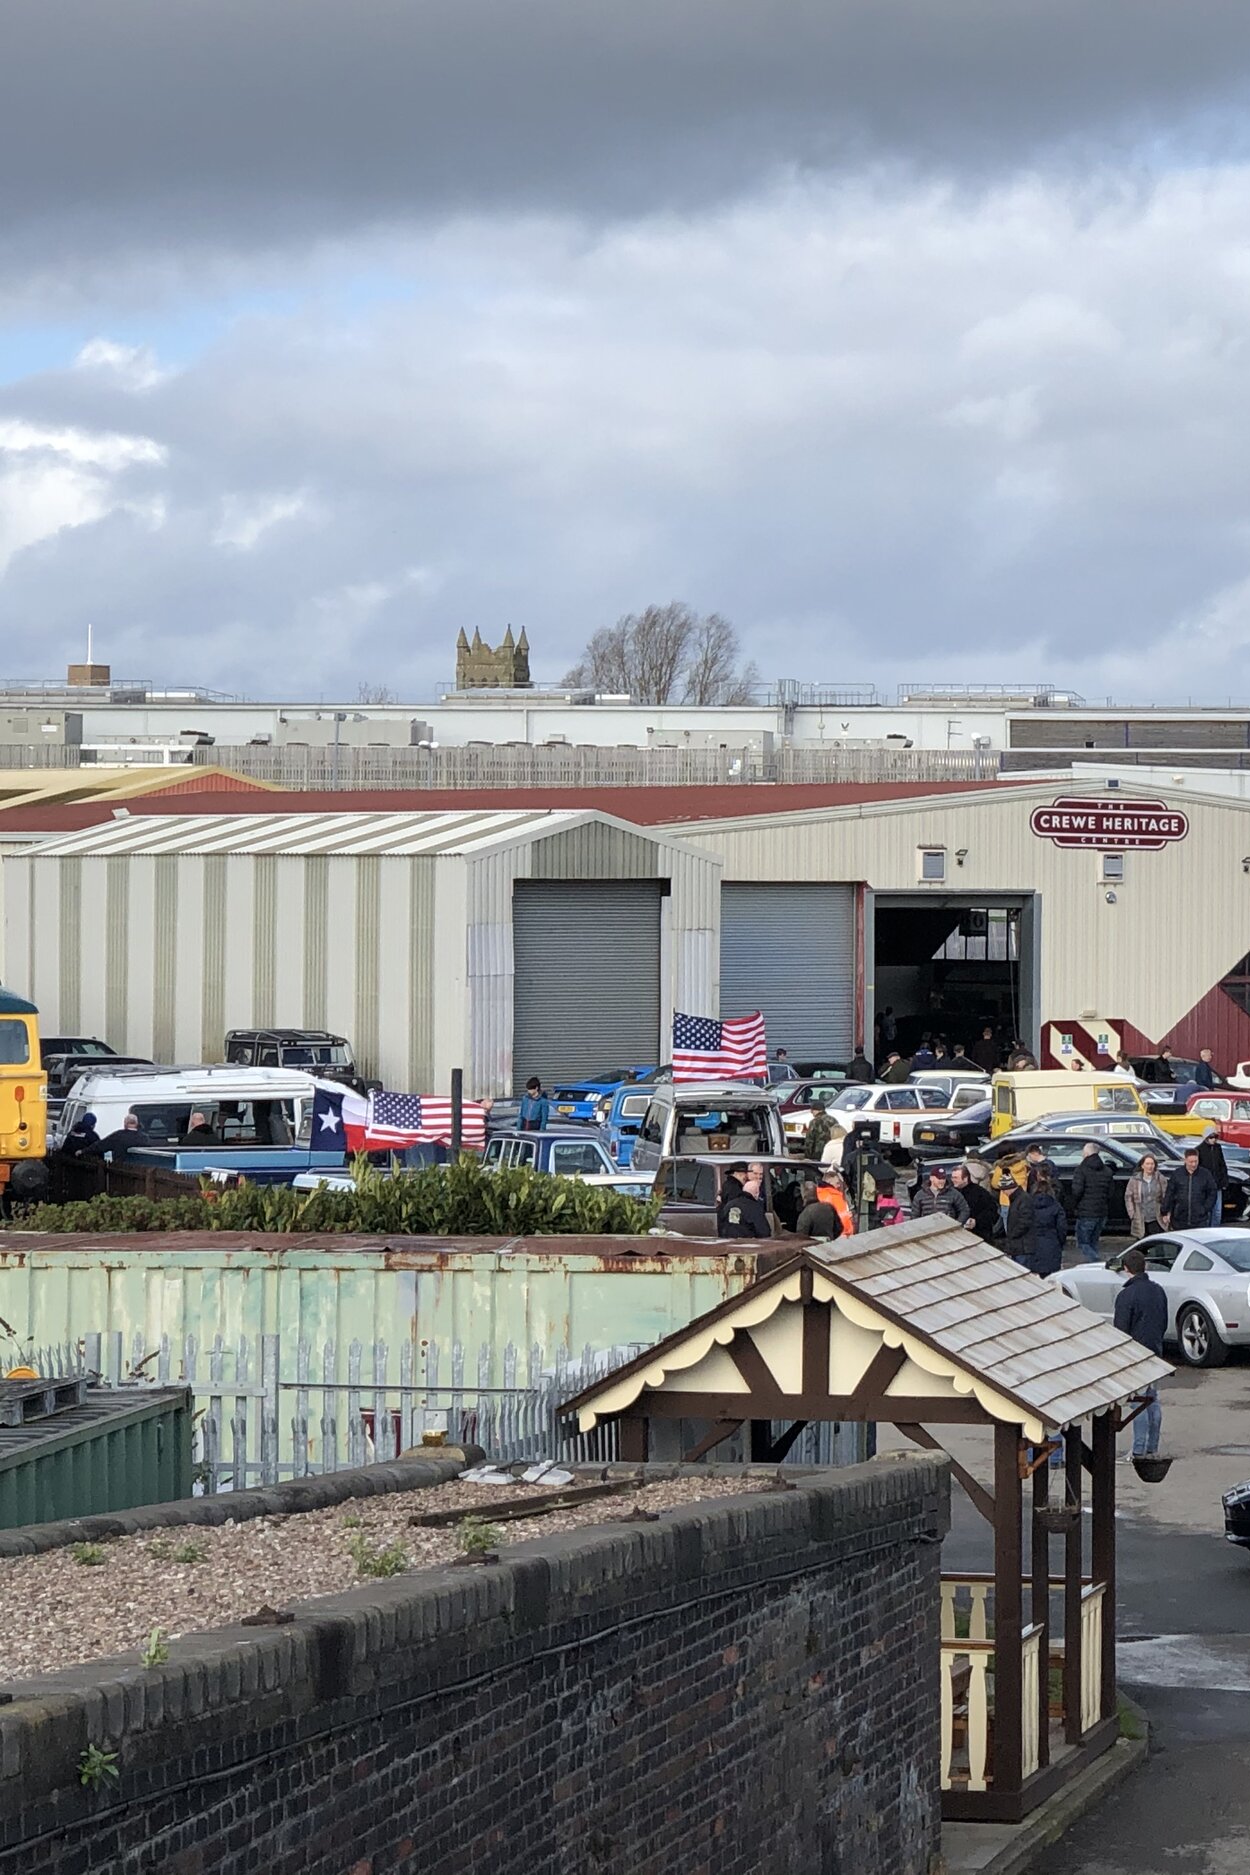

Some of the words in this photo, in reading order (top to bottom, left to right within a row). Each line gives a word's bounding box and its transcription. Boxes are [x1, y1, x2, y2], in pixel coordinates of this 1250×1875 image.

[1040, 815, 1096, 829] CREWE
[1103, 817, 1179, 831] HERITAGE
[1081, 837, 1139, 845] CENTRE
